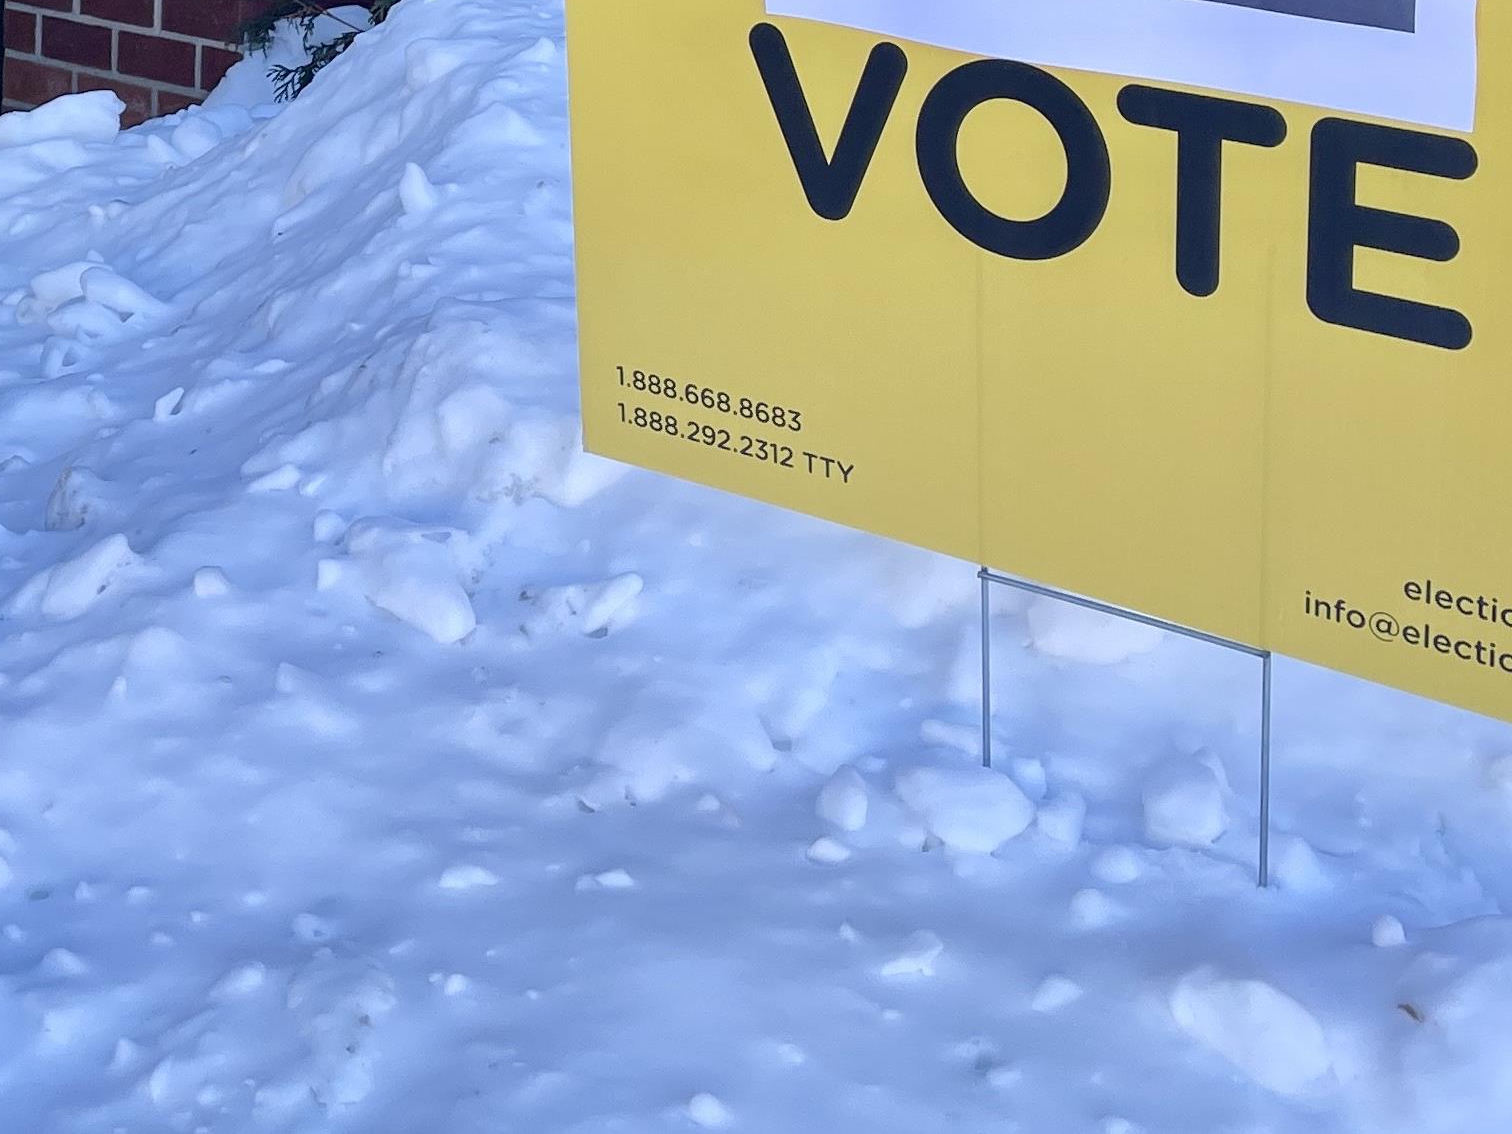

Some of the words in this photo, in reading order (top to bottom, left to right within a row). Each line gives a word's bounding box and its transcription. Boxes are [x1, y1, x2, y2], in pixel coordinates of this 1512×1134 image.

[749, 22, 1478, 350] VOTE
[616, 366, 802, 432] 1.888.668.8683
[617, 402, 794, 468] 1.888.292.2312
[802, 451, 855, 483] TTY
